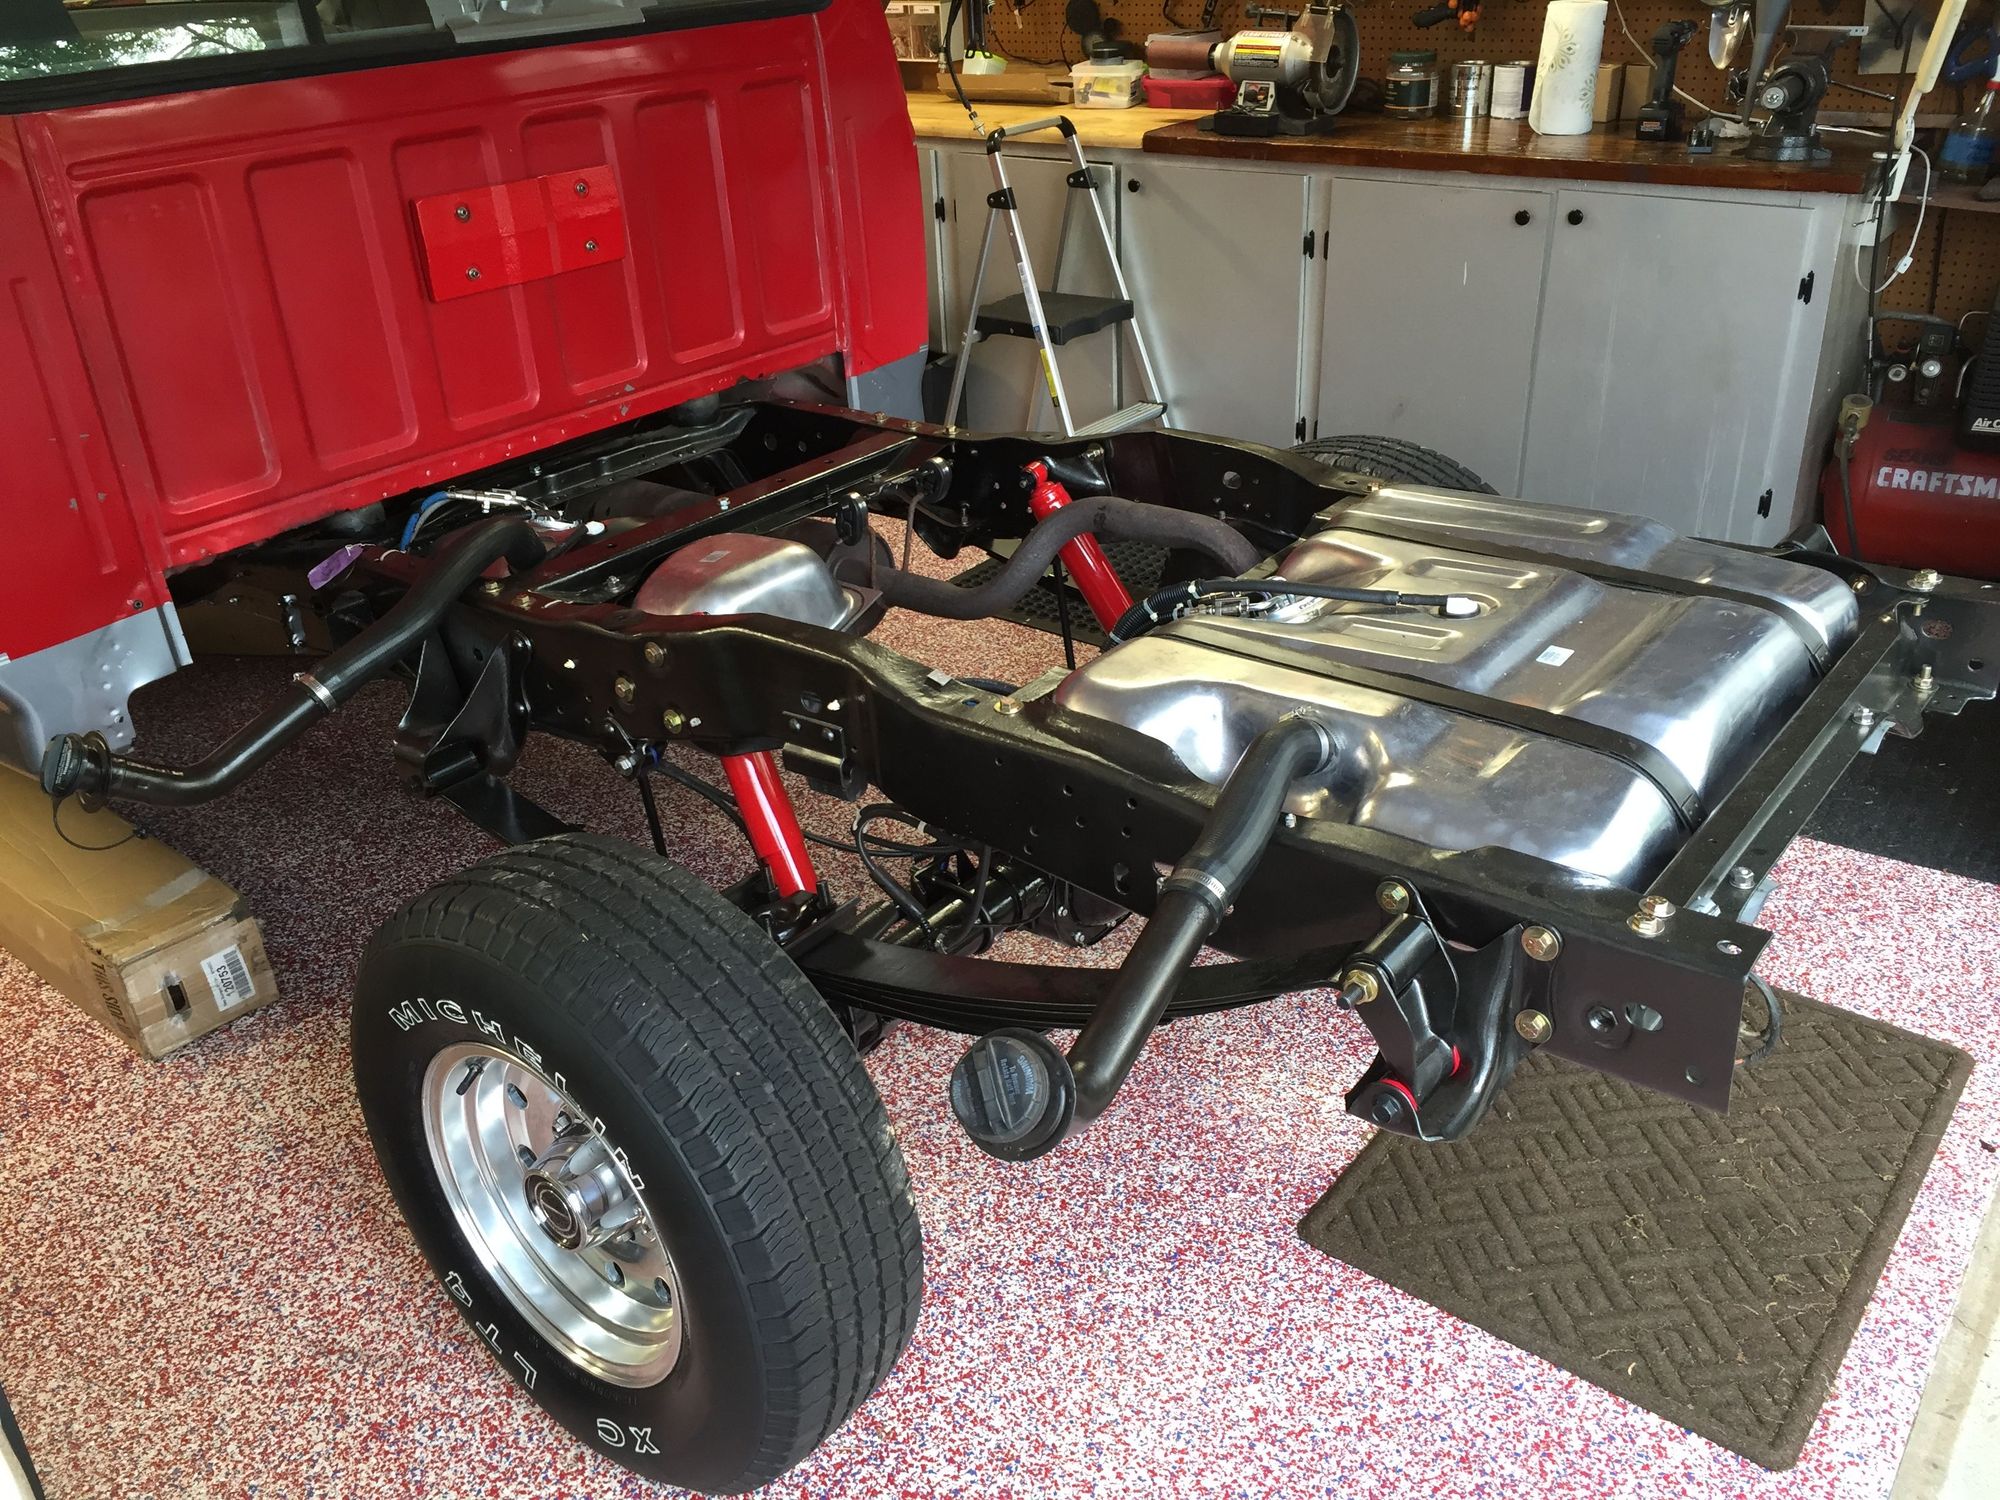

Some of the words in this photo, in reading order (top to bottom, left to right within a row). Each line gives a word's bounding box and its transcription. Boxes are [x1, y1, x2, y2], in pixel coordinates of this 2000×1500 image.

[1973, 417, 1992, 428] Air
[1877, 466, 2000, 499] CRAFTSM
[216, 965, 236, 997] 120753
[597, 1418, 661, 1454] XC
